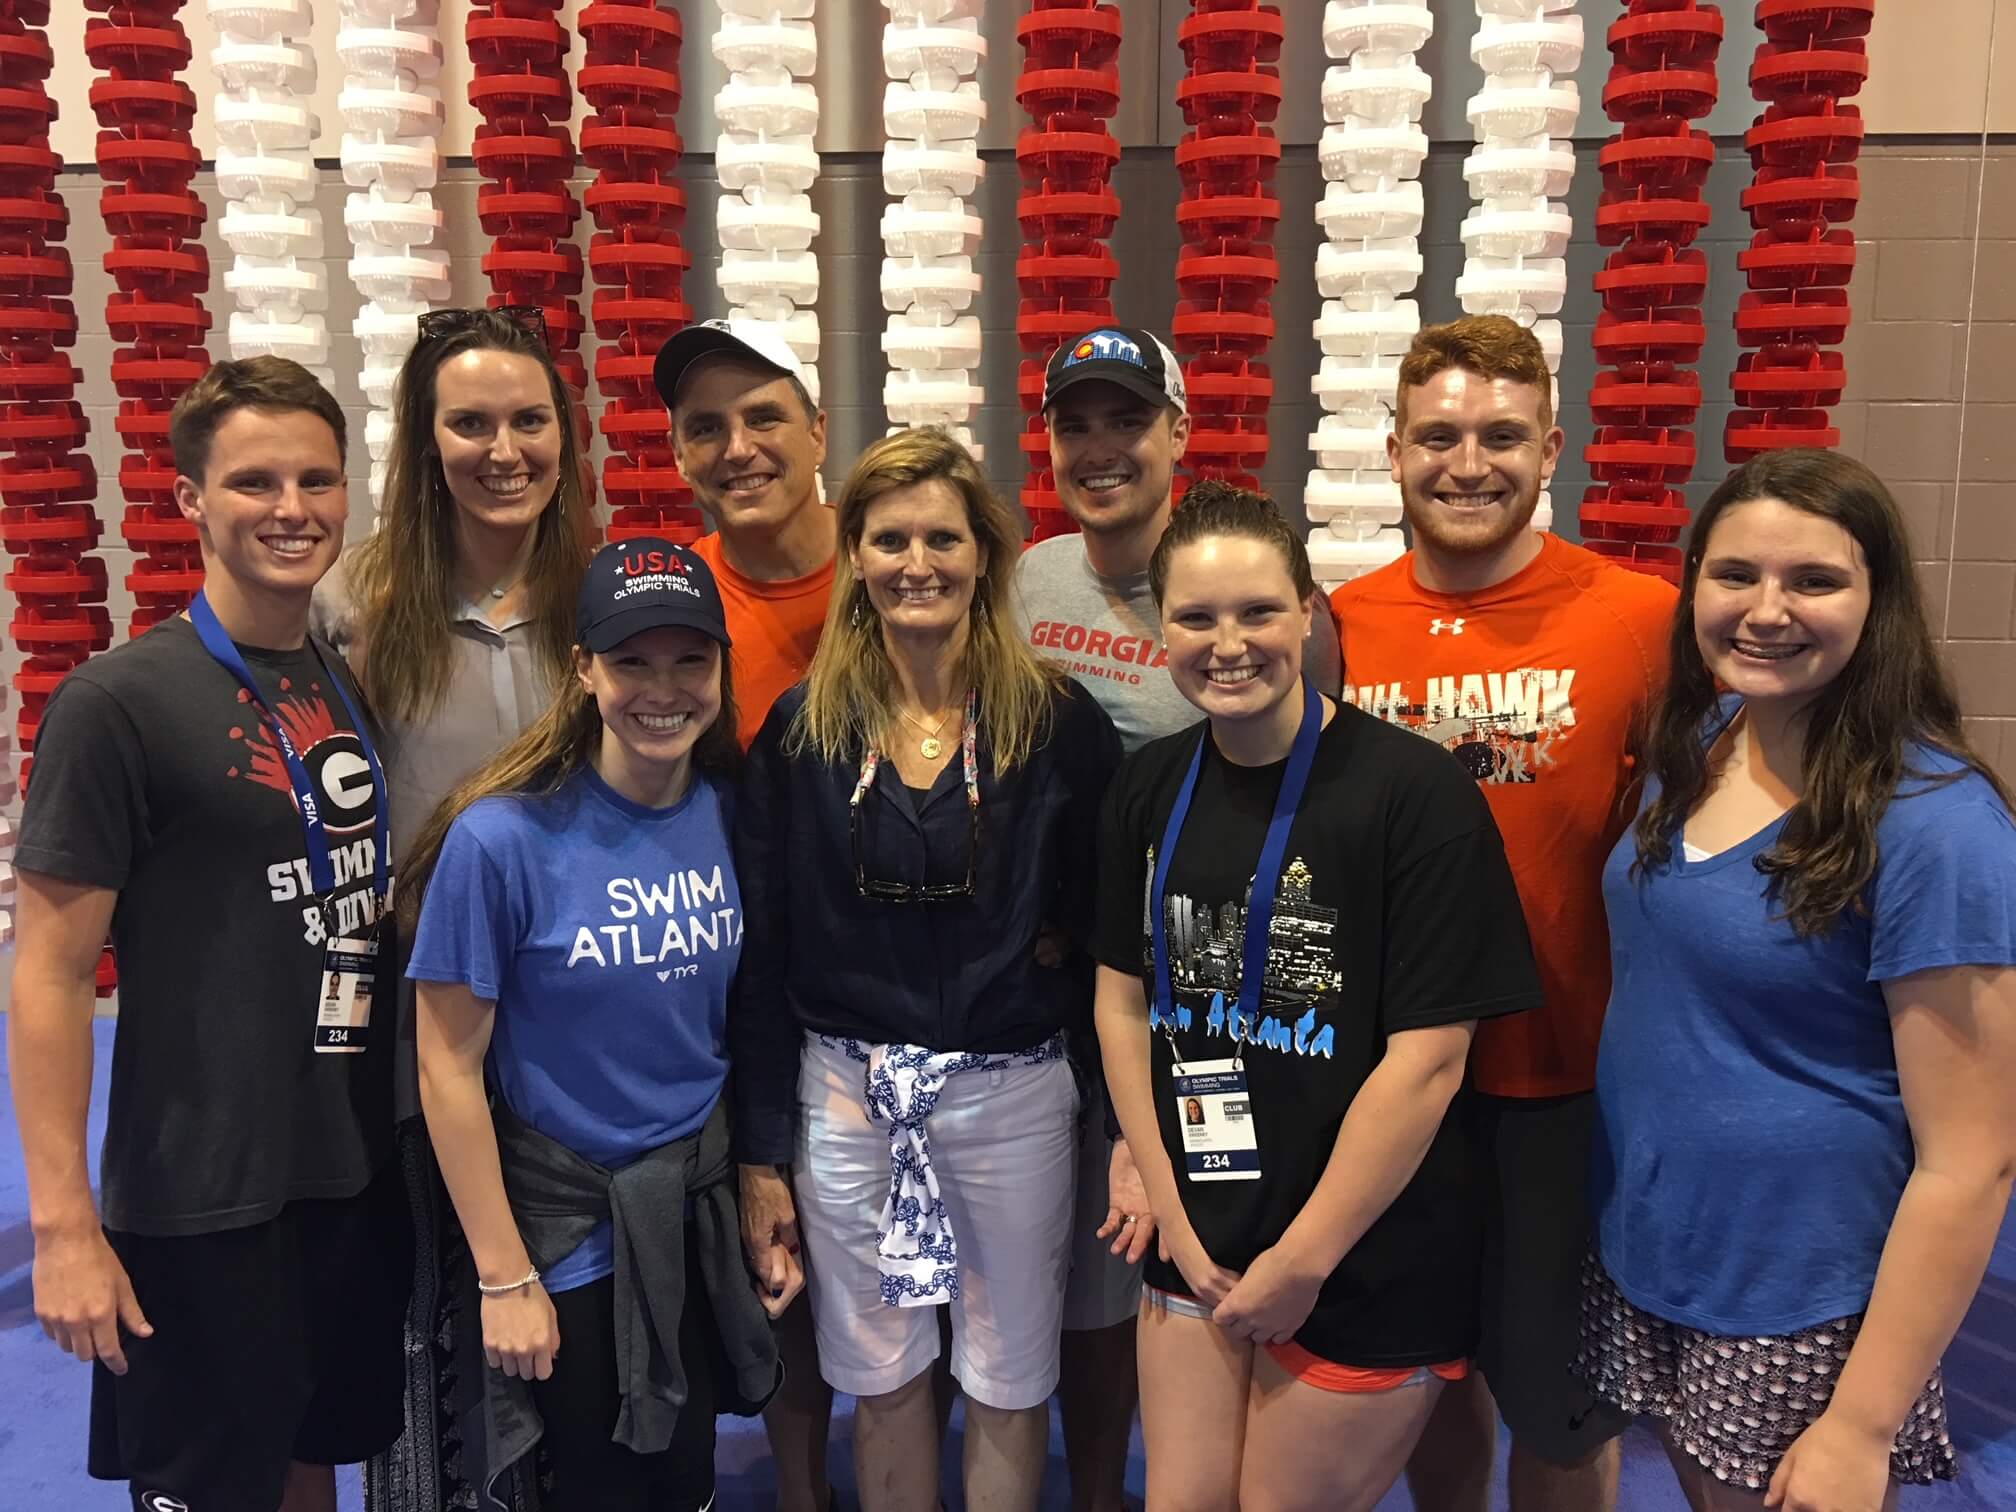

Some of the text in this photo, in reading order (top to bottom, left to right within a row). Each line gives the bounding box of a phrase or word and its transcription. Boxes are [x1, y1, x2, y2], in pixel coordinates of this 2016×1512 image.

[624, 551, 687, 577] USA
[625, 574, 689, 587] SWIMMING
[614, 582, 701, 600] OLYMPIC TRIALS
[1425, 667, 1576, 736] HAWK
[302, 792, 318, 828] VISA
[606, 865, 726, 918] SWIM
[302, 906, 327, 945] &
[673, 964, 699, 980] TYR
[328, 1029, 348, 1043] 234
[1224, 1104, 1243, 1112] CLUB
[1202, 1154, 1230, 1168] 234
